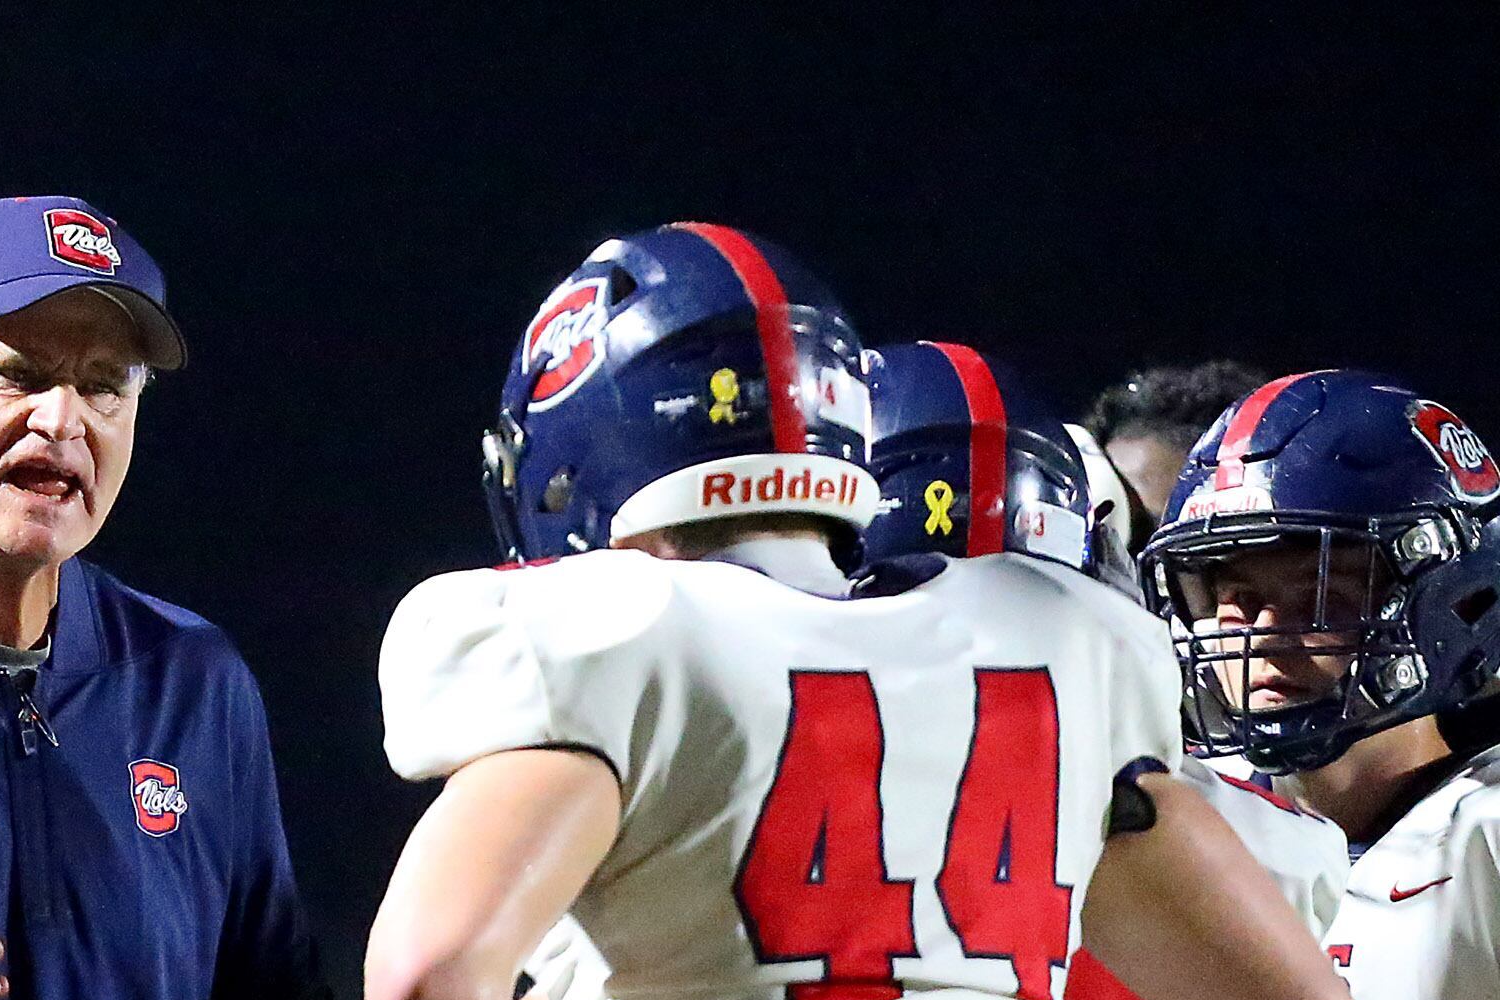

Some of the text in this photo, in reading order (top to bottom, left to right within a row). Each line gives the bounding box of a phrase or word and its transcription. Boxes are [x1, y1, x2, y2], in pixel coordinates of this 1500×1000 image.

[53, 224, 120, 263] Vols
[1439, 422, 1487, 469] Vol
[702, 466, 859, 509] Riddell
[134, 778, 189, 815] Vols
